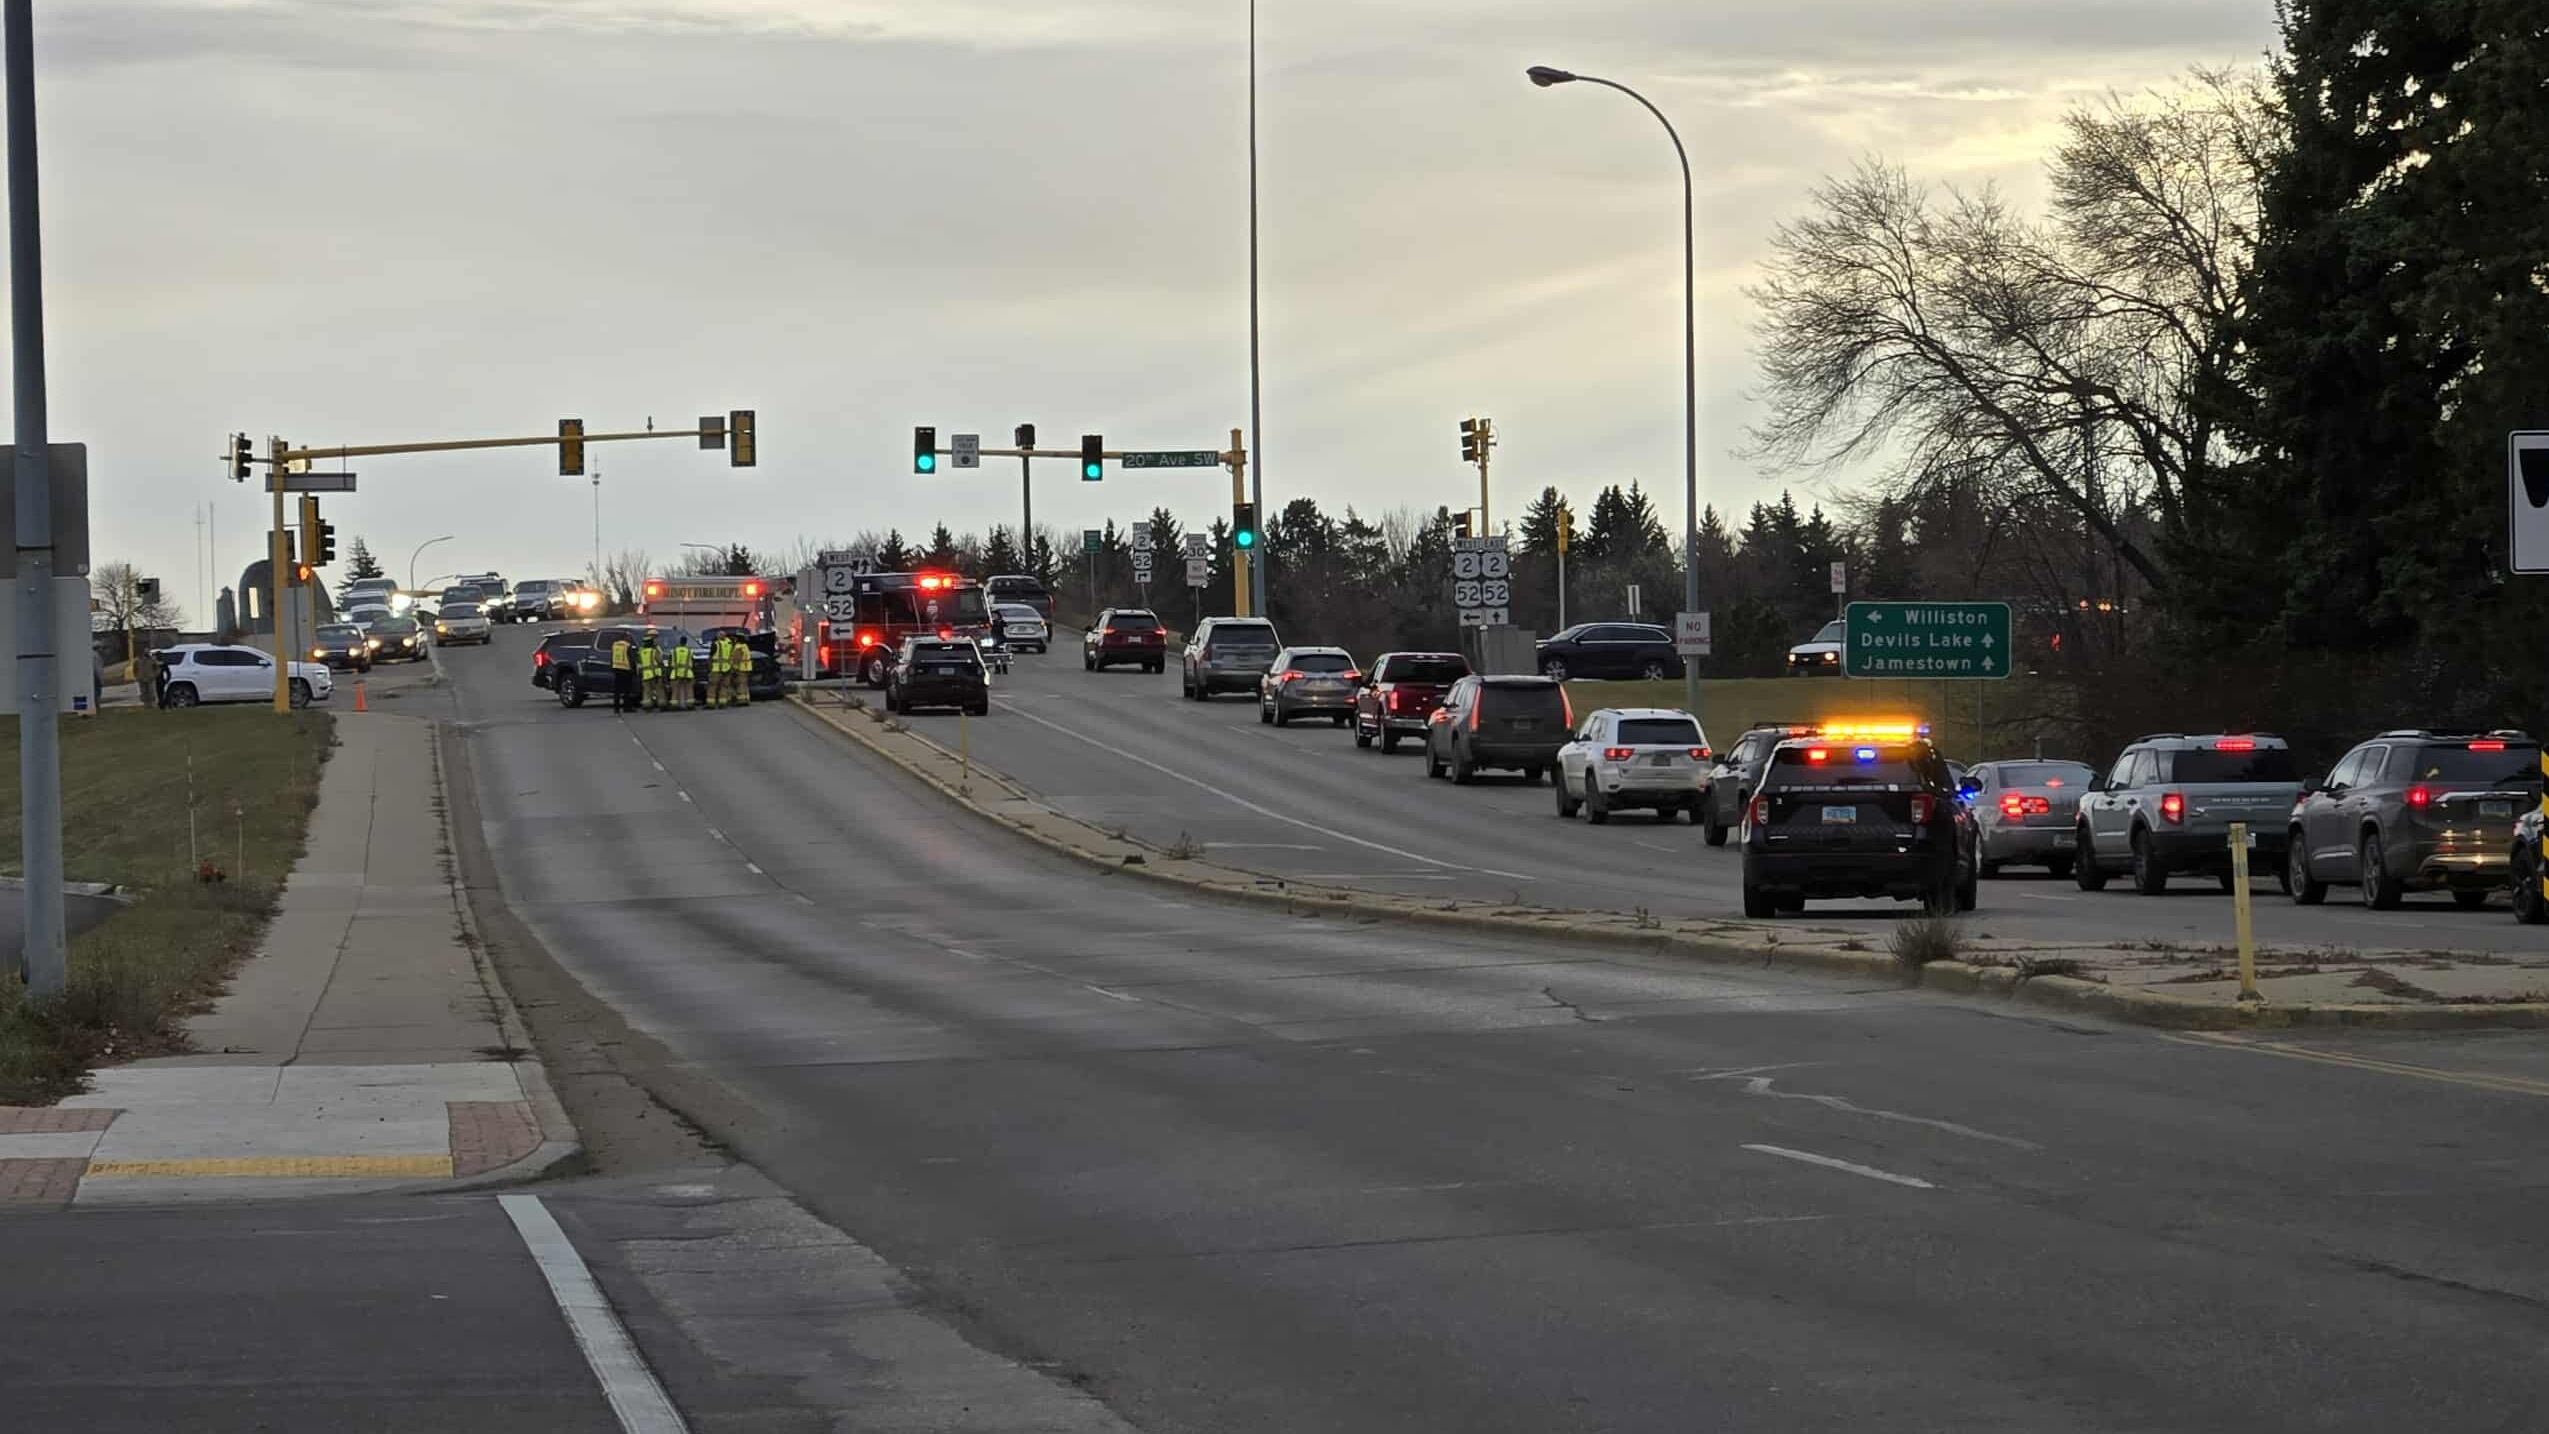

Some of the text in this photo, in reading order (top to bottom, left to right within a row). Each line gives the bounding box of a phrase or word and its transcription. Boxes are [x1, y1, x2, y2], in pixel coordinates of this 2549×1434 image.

[1159, 454, 1185, 466] Ave
[1193, 452, 1217, 465] SW
[1139, 536, 1147, 547] 2
[829, 553, 851, 563] WEST
[1189, 546, 1205, 557] 30
[1135, 555, 1150, 567] 52
[1462, 557, 1473, 573] 2
[1489, 556, 1500, 572] 2
[834, 571, 845, 587] 2
[1458, 586, 1479, 601] 52
[1485, 585, 1507, 600] 52
[830, 600, 852, 615] 52
[1905, 610, 1988, 625] Williston
[1686, 621, 1701, 632] NO
[1861, 632, 1973, 647] Devils Lake
[1862, 655, 1972, 670] Jamestown
